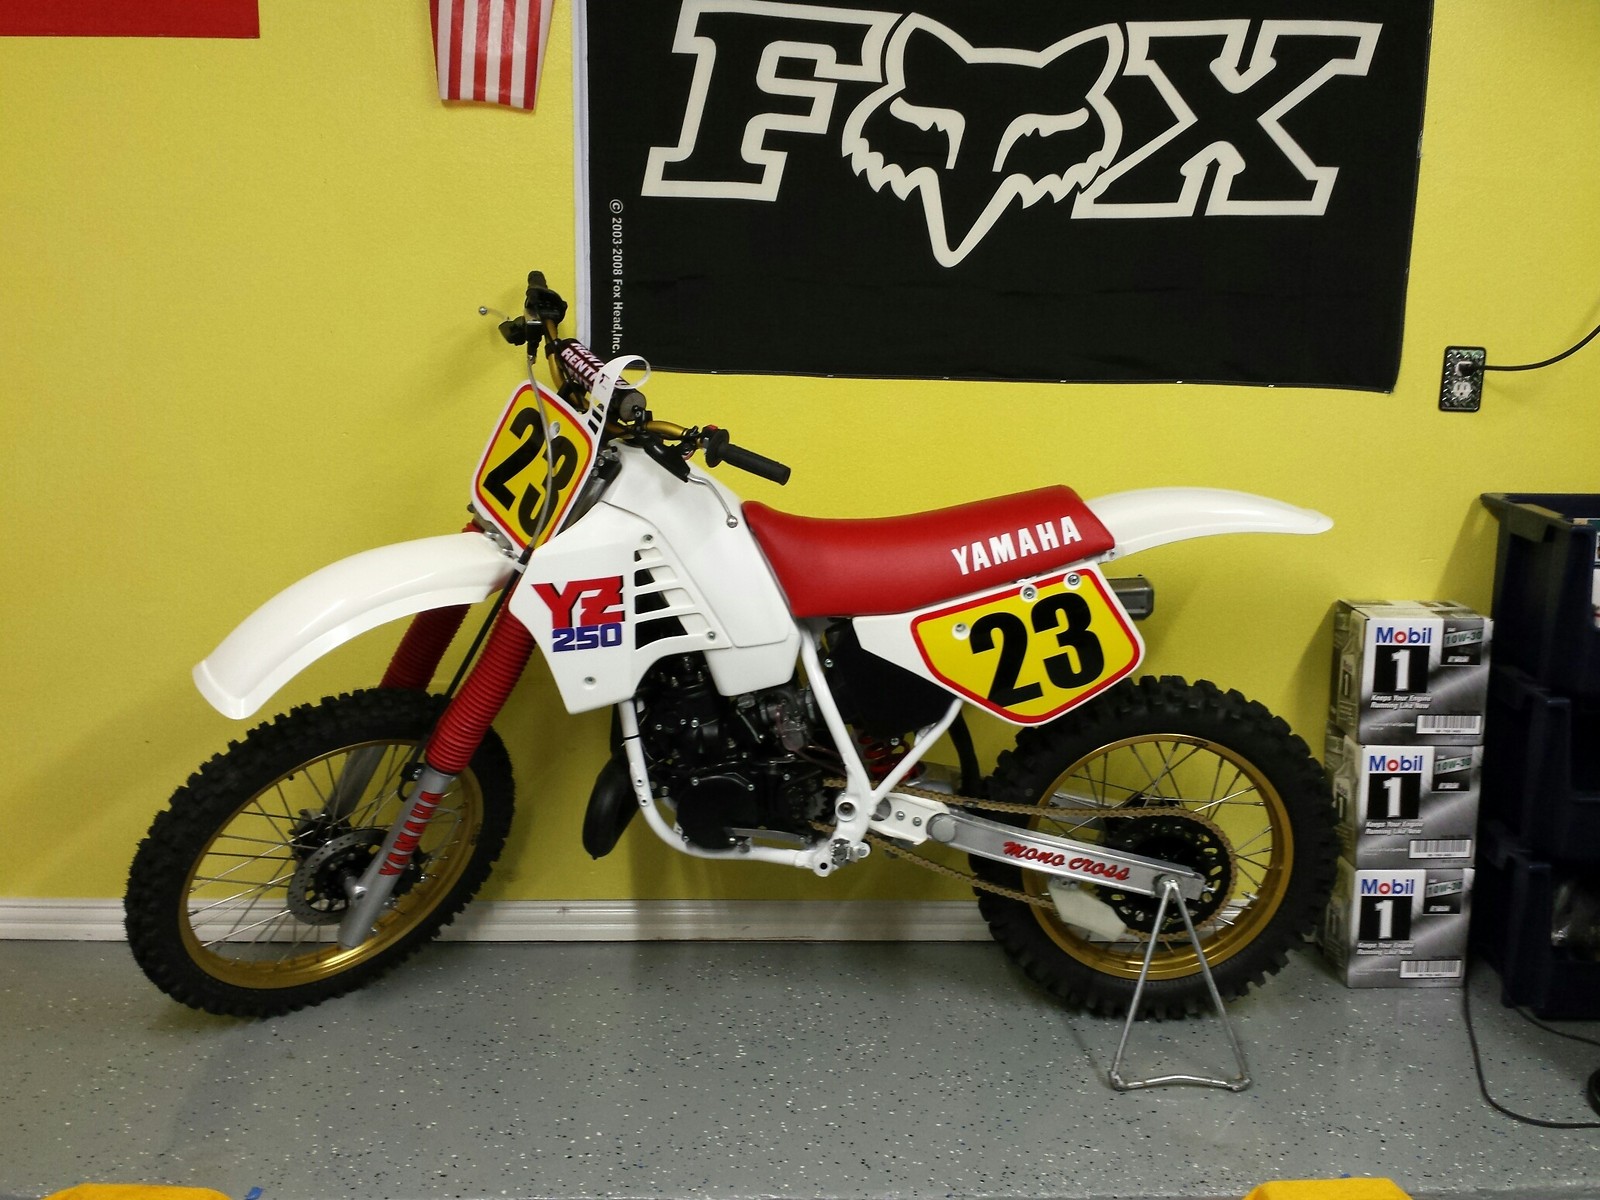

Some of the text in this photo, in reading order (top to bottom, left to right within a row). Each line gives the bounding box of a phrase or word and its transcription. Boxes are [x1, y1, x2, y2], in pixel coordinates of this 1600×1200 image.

[612, 279, 623, 298] Fox
[482, 406, 579, 538] 23
[951, 515, 1082, 576] YAMAHA
[531, 574, 626, 629] YZ
[552, 622, 623, 653] 250
[968, 591, 1105, 708] 23
[1375, 627, 1433, 644] Mobil
[1391, 649, 1411, 692] 1
[1369, 755, 1424, 772] Mobil
[1382, 776, 1403, 818] 1
[1003, 841, 1131, 881] mono cross
[1361, 878, 1415, 895] Mobil
[1374, 899, 1394, 939] 1
